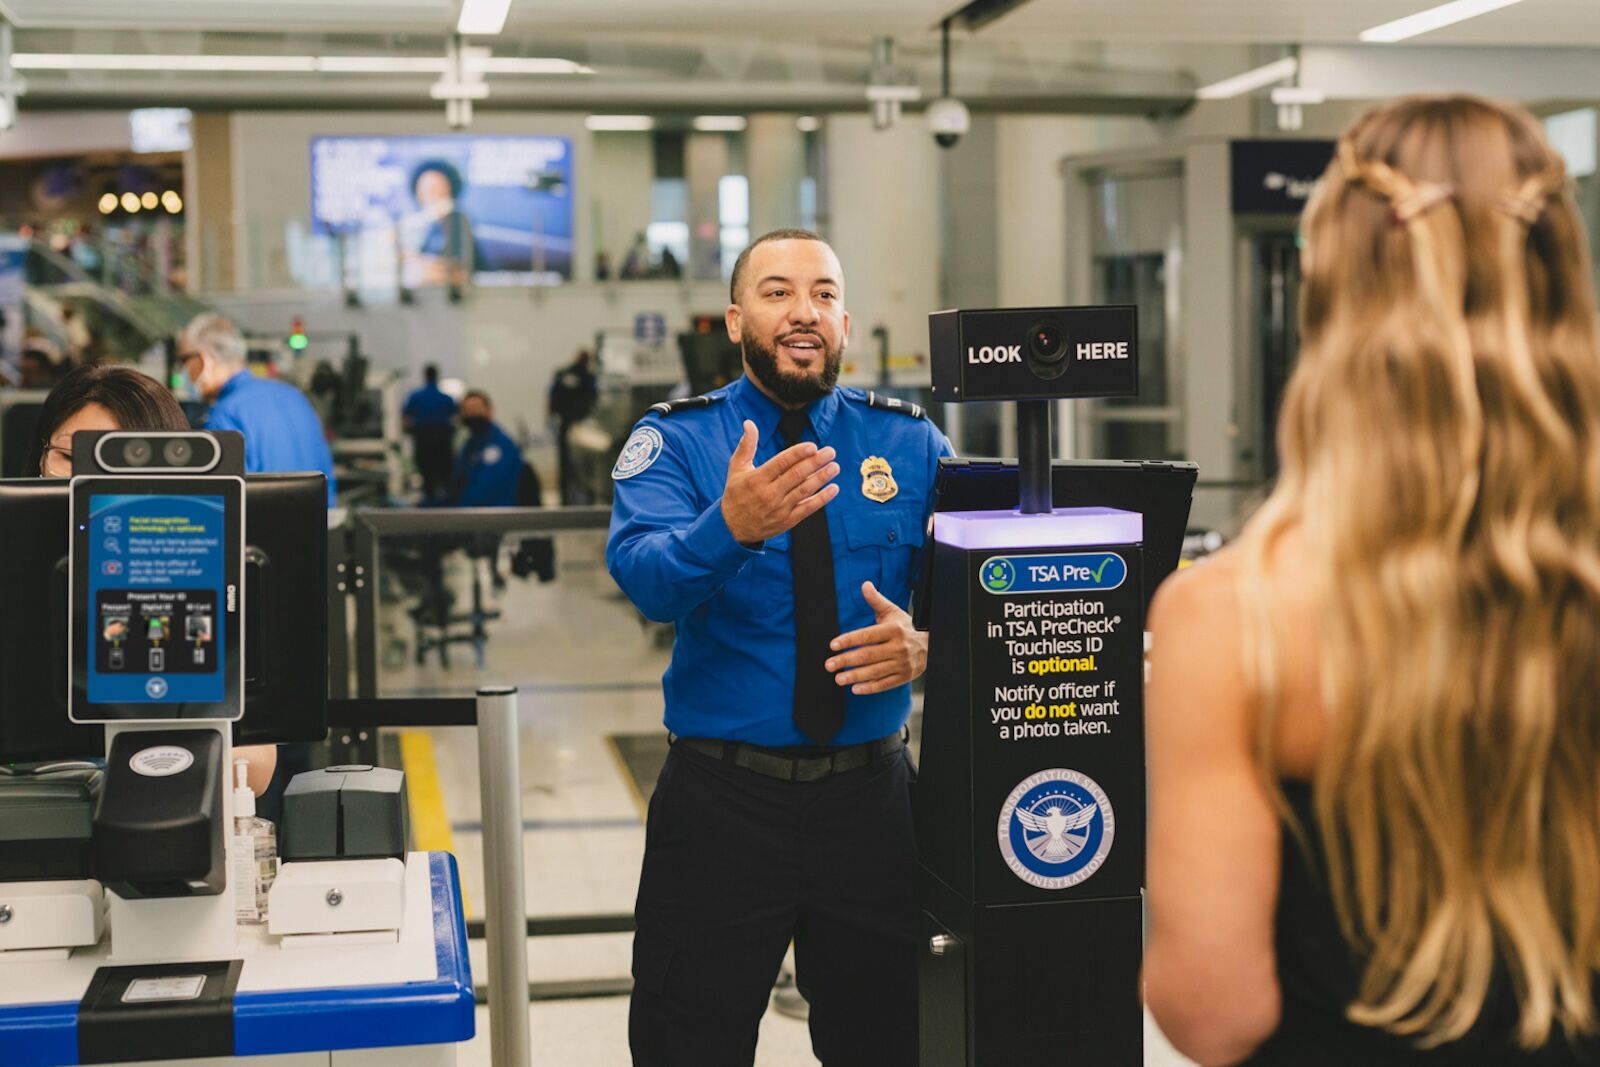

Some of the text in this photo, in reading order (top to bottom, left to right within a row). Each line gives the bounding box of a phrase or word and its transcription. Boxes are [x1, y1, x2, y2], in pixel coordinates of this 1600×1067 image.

[968, 342, 1128, 364] LOOK HERE
[1028, 565, 1090, 582] TSA Pre
[127, 592, 156, 600] Present
[158, 592, 175, 600] Your
[1004, 599, 1104, 618] Participation
[988, 622, 1002, 638] in
[1006, 621, 1037, 637] TSA
[1006, 638, 1103, 656] Touchless ID
[1012, 656, 1098, 676] is optional.
[995, 680, 1116, 703] Notify officer if
[991, 700, 1119, 724] you do not want
[999, 719, 1111, 741] a photo taken.
[999, 770, 1114, 840] TRANSPORTATION SECURITY
[1006, 854, 1106, 888] ADMINISTRATION
